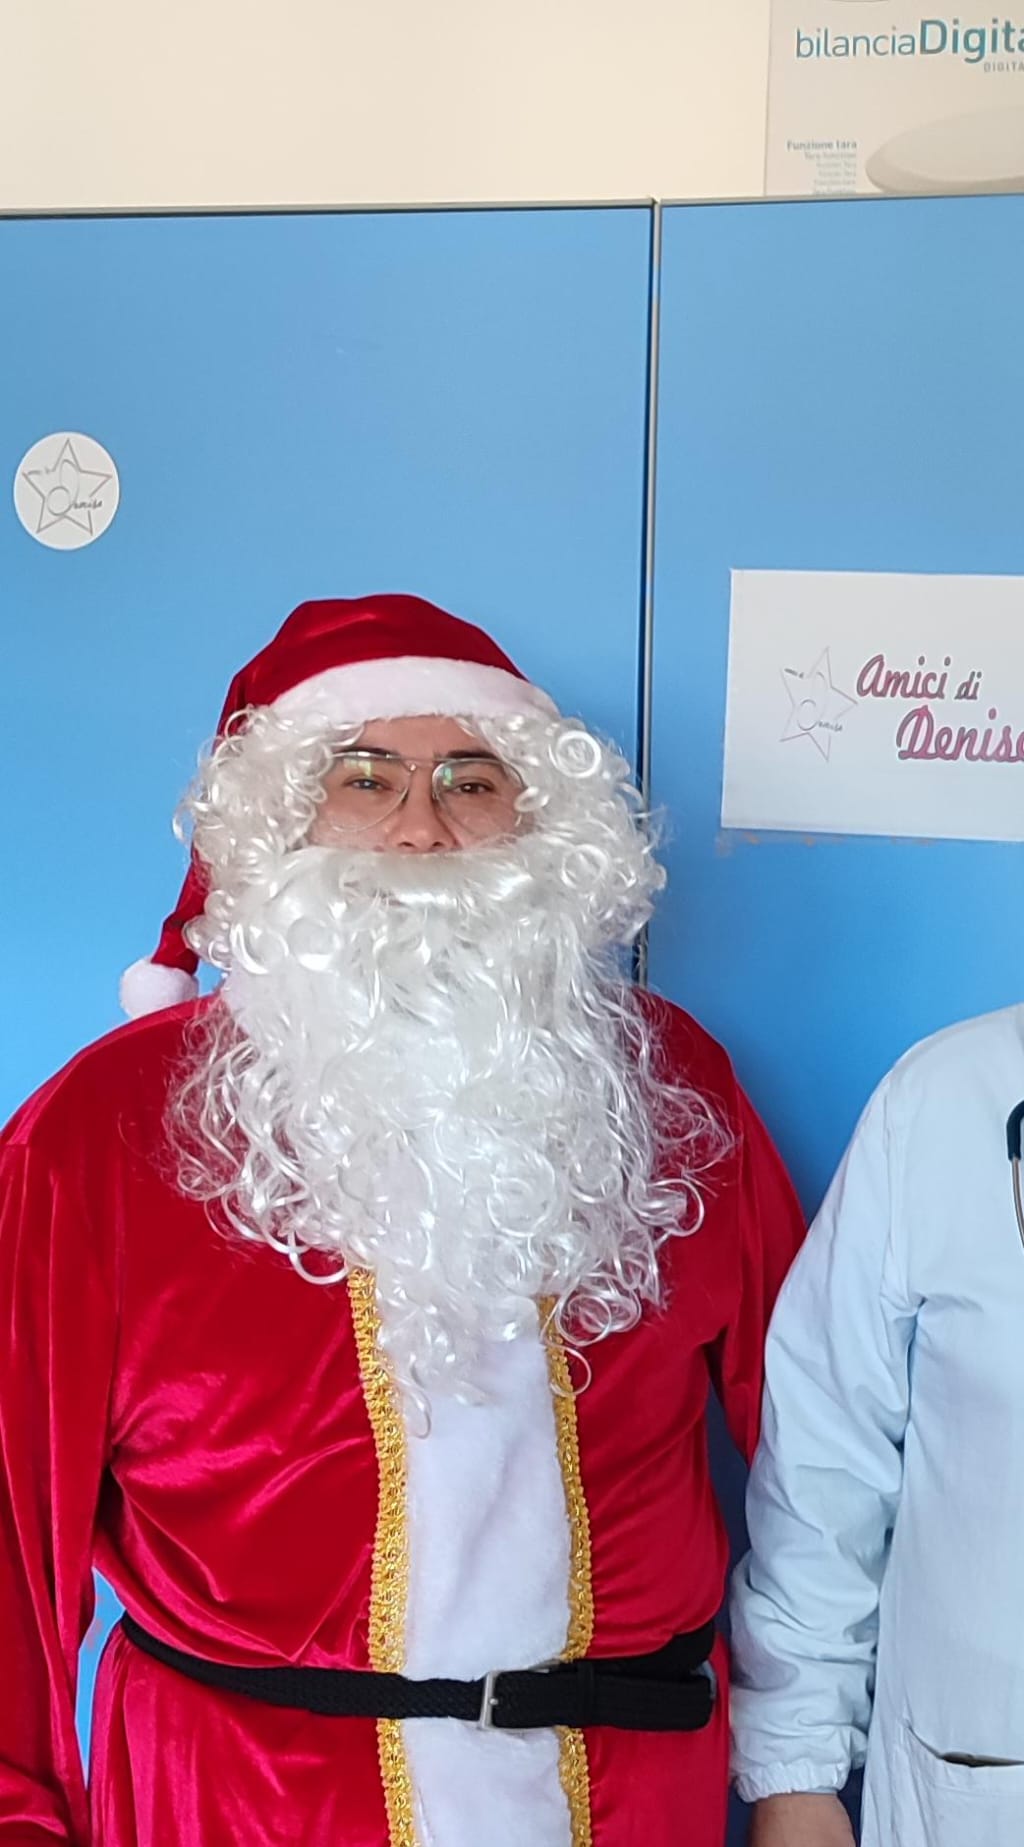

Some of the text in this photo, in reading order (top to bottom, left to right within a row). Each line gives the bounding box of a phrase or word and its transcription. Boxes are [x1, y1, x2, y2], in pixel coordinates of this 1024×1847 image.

[786, 140, 833, 151] Funzione
[856, 653, 983, 701] Amici di
